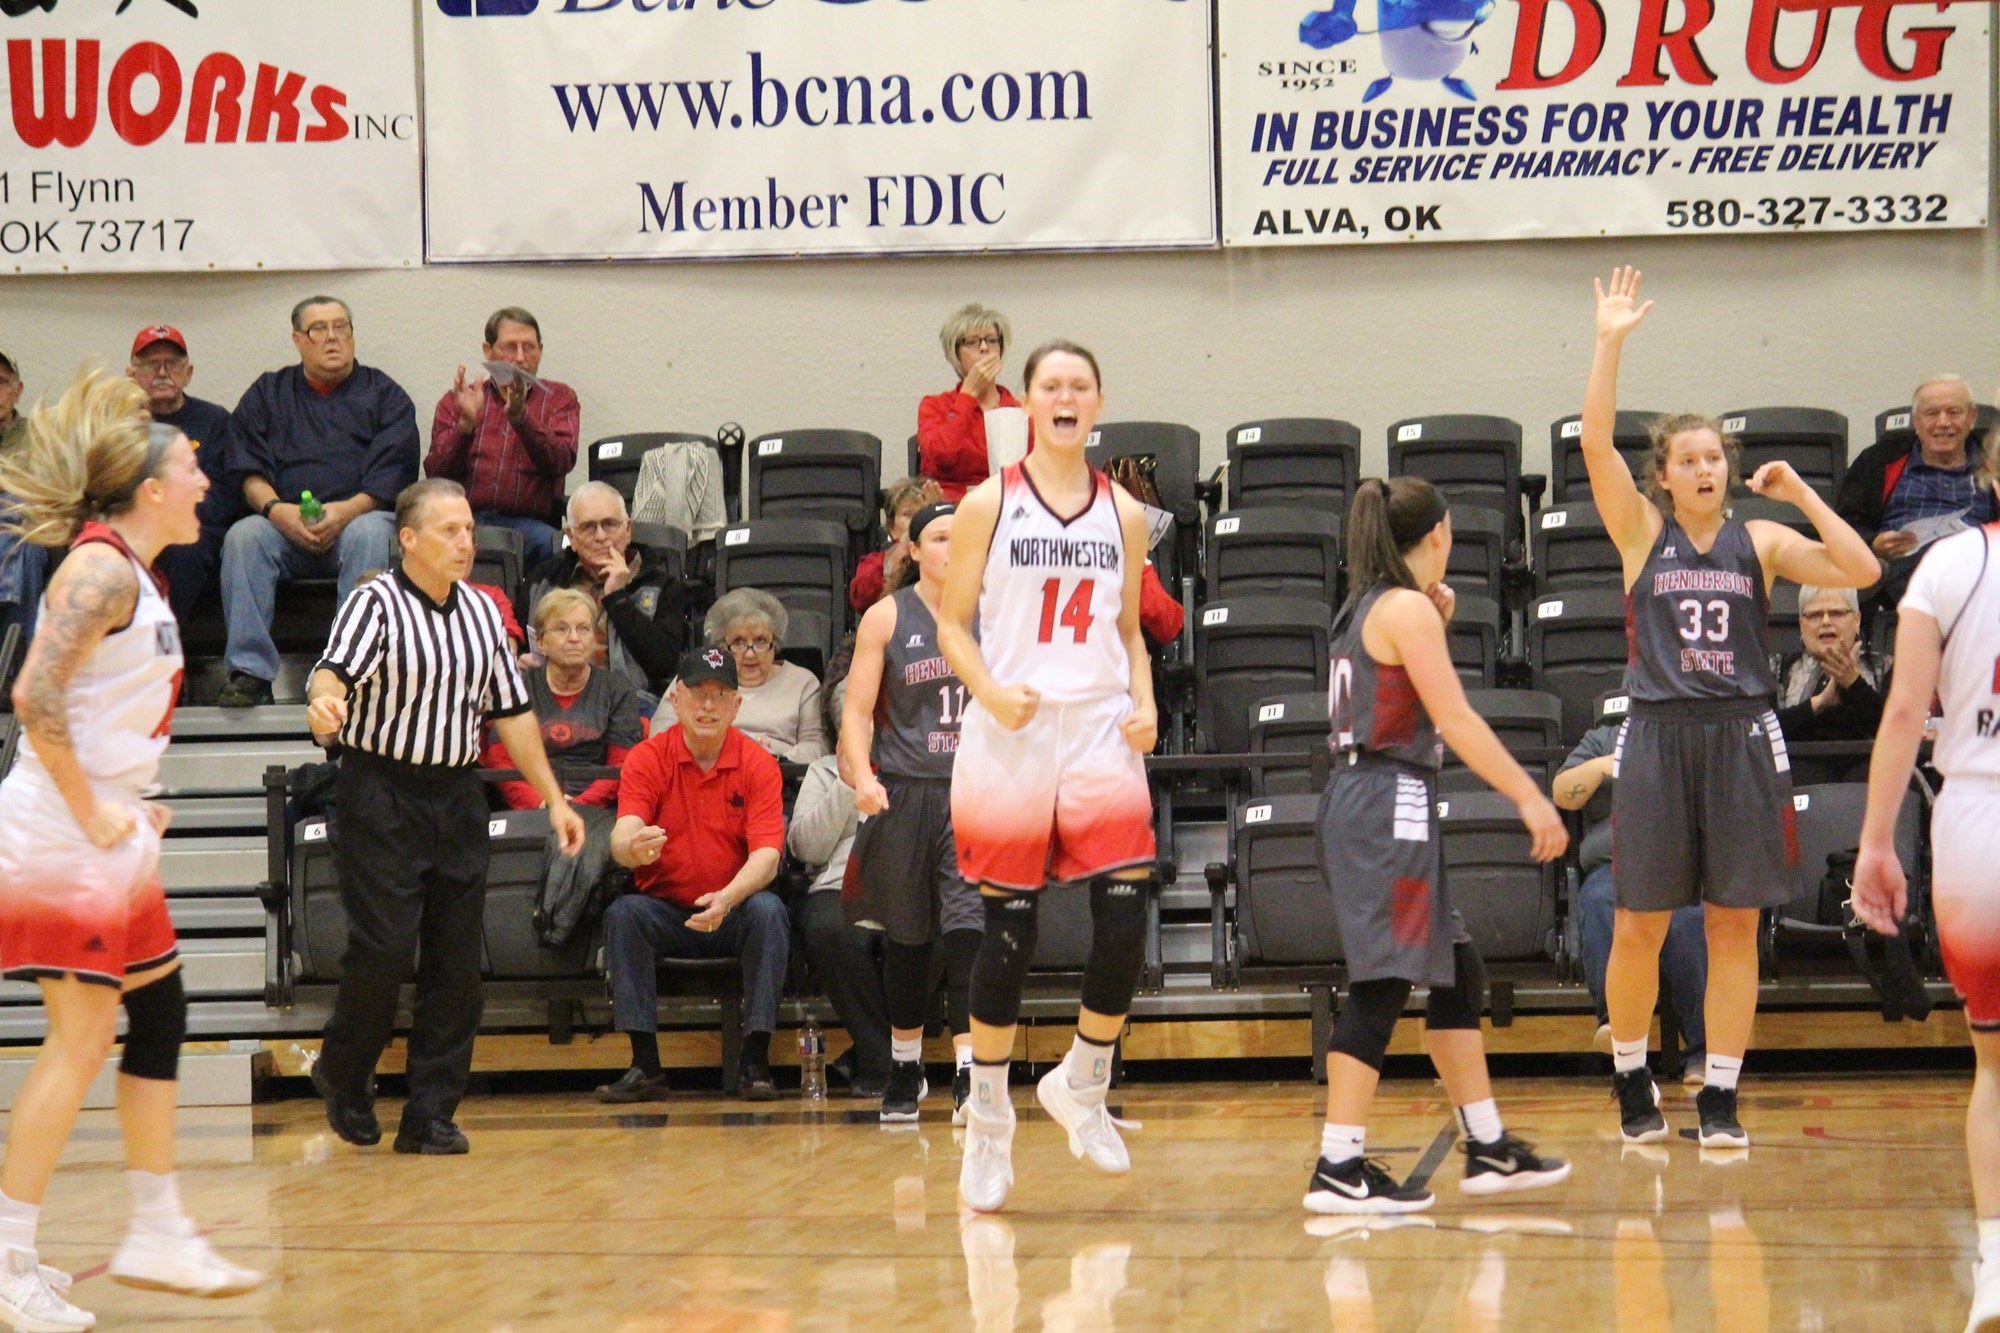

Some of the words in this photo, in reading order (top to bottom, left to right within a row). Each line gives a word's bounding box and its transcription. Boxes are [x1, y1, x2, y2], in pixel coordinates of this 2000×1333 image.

[1495, 0, 1956, 90] DRUG
[1258, 60, 1357, 76] SINCE
[7, 38, 349, 148] WORKS
[355, 113, 413, 139] INC
[551, 52, 1092, 132] www.bcna.com
[1281, 78, 1335, 92] 1952
[1251, 112, 1298, 152] IN
[1311, 106, 1528, 150] BUSINESS
[1541, 102, 1629, 143] FOR
[1646, 99, 1764, 140] YOUR
[1776, 94, 1952, 136] HEALTH
[1263, 158, 1339, 186] FULL
[1350, 154, 1484, 183] SERVICE
[1490, 148, 1669, 179] PHARMACY
[1689, 145, 1773, 173] FREE
[1777, 141, 1938, 171] DELIVERY
[32, 171, 134, 212] Flynn
[636, 177, 848, 232] Member
[865, 173, 1006, 227] FDIC
[1253, 208, 1369, 239] ALVA,
[1385, 205, 1442, 232] OK
[1667, 194, 1949, 228] 580-327-3332
[0, 221, 60, 253] OK
[76, 220, 194, 252] 73717
[1244, 432, 1256, 441] 14
[1405, 426, 1417, 437] 15
[1569, 422, 1580, 433] 16
[1729, 419, 1741, 430] 17
[766, 442, 776, 452] 11
[1223, 521, 1233, 531] 11
[1550, 514, 1561, 525] 13
[1010, 538, 1119, 572] NORTHWESTERN
[1654, 569, 1753, 599] HENDERSON
[1038, 577, 1095, 643] 14
[1211, 611, 1221, 621] 11
[1680, 599, 1729, 641] 33
[1681, 647, 1734, 674] STATE
[939, 685, 965, 723] 11
[1267, 707, 1278, 718] 11
[1611, 699, 1623, 711] 13
[1254, 808, 1265, 819] 11
